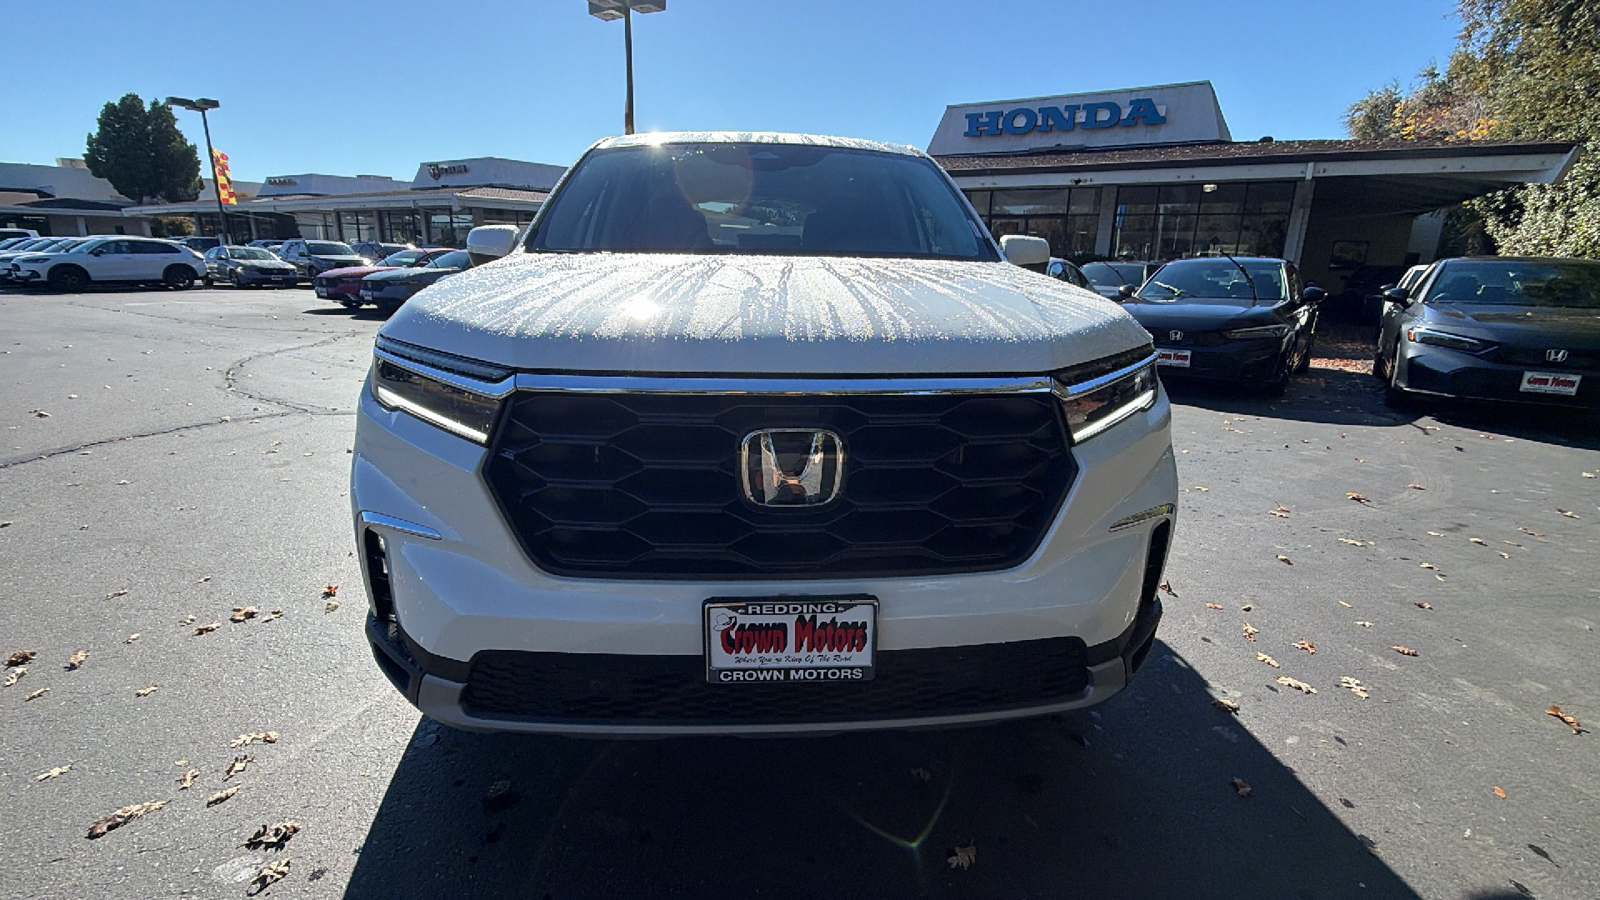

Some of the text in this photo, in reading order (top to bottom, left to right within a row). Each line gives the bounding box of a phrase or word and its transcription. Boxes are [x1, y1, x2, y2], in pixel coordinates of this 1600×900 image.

[963, 98, 1167, 137] HONDA
[748, 604, 836, 614] REDDING
[720, 614, 868, 654] Crown Motors
[785, 655, 802, 664] King
[719, 668, 863, 682] CROWN MOTORS
